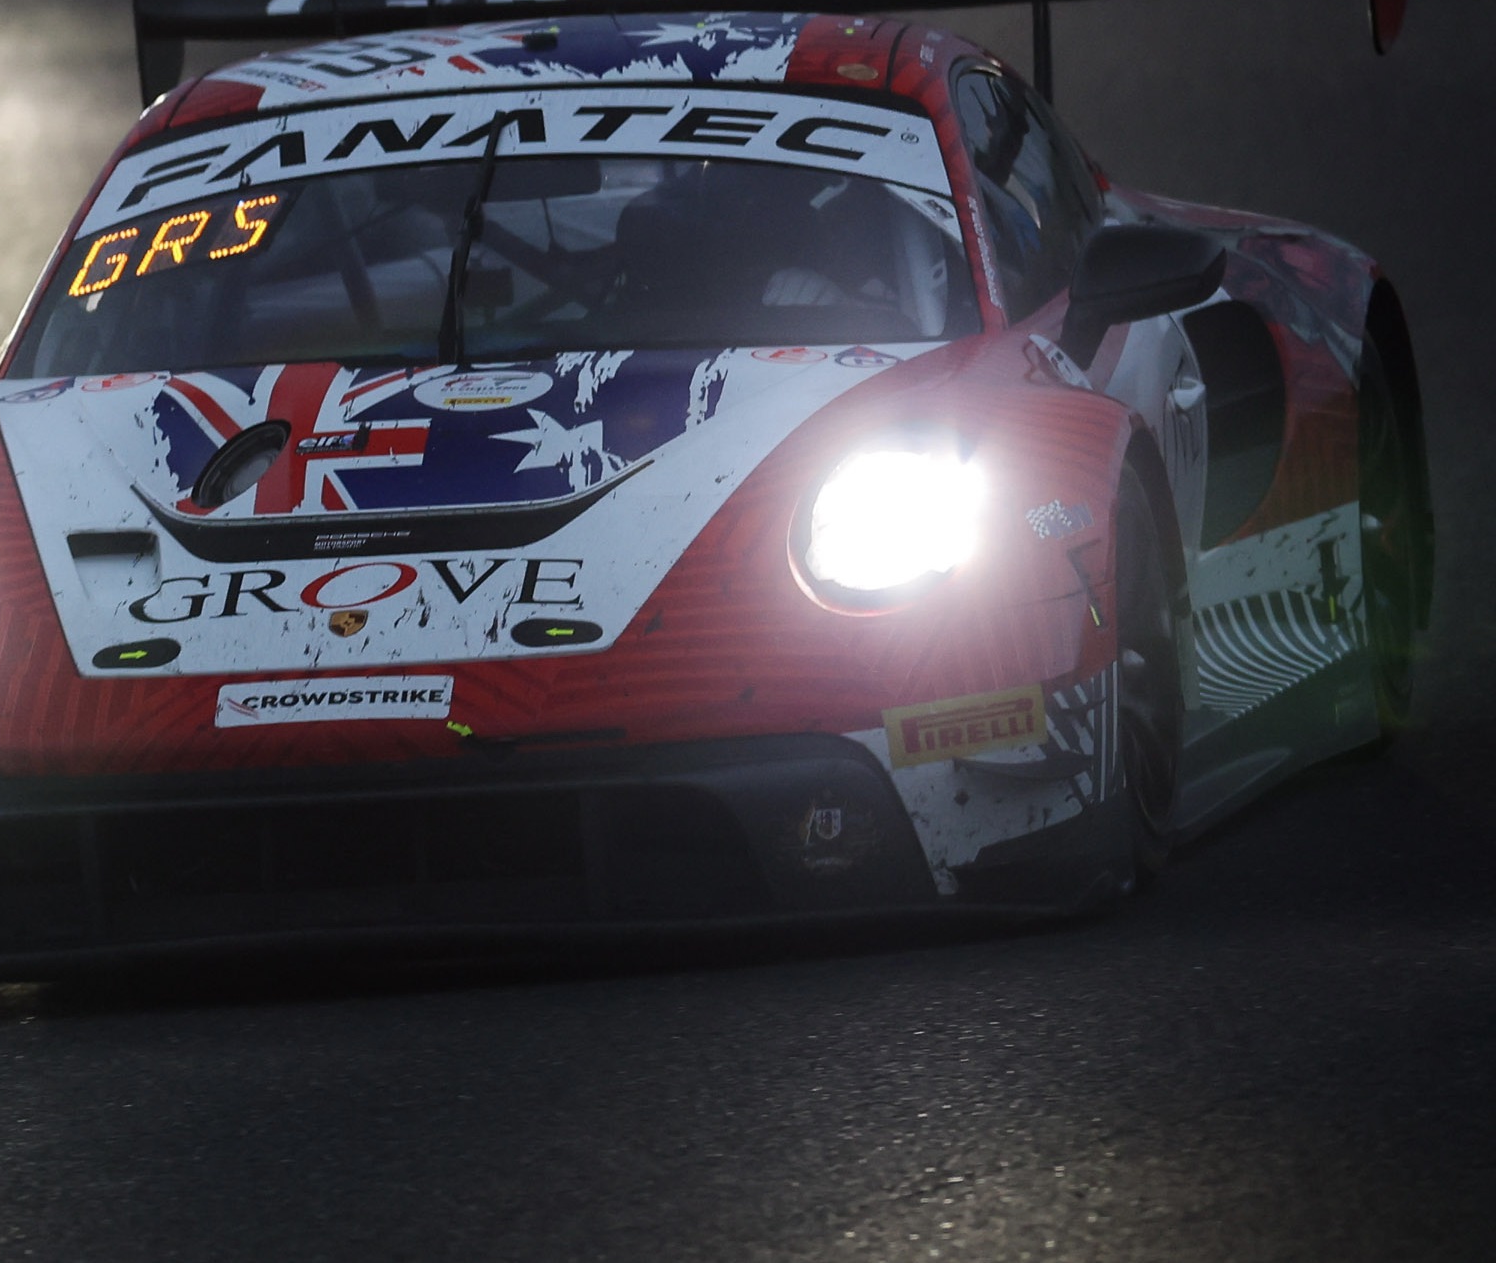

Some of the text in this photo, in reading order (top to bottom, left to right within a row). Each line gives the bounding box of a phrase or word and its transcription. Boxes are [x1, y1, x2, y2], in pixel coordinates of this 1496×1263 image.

[119, 105, 892, 210] FANATEC
[68, 193, 279, 299] GRS
[128, 558, 586, 625] GROVE
[242, 688, 445, 710] CROWDSTRIKE
[901, 697, 1034, 754] PIRELLI
